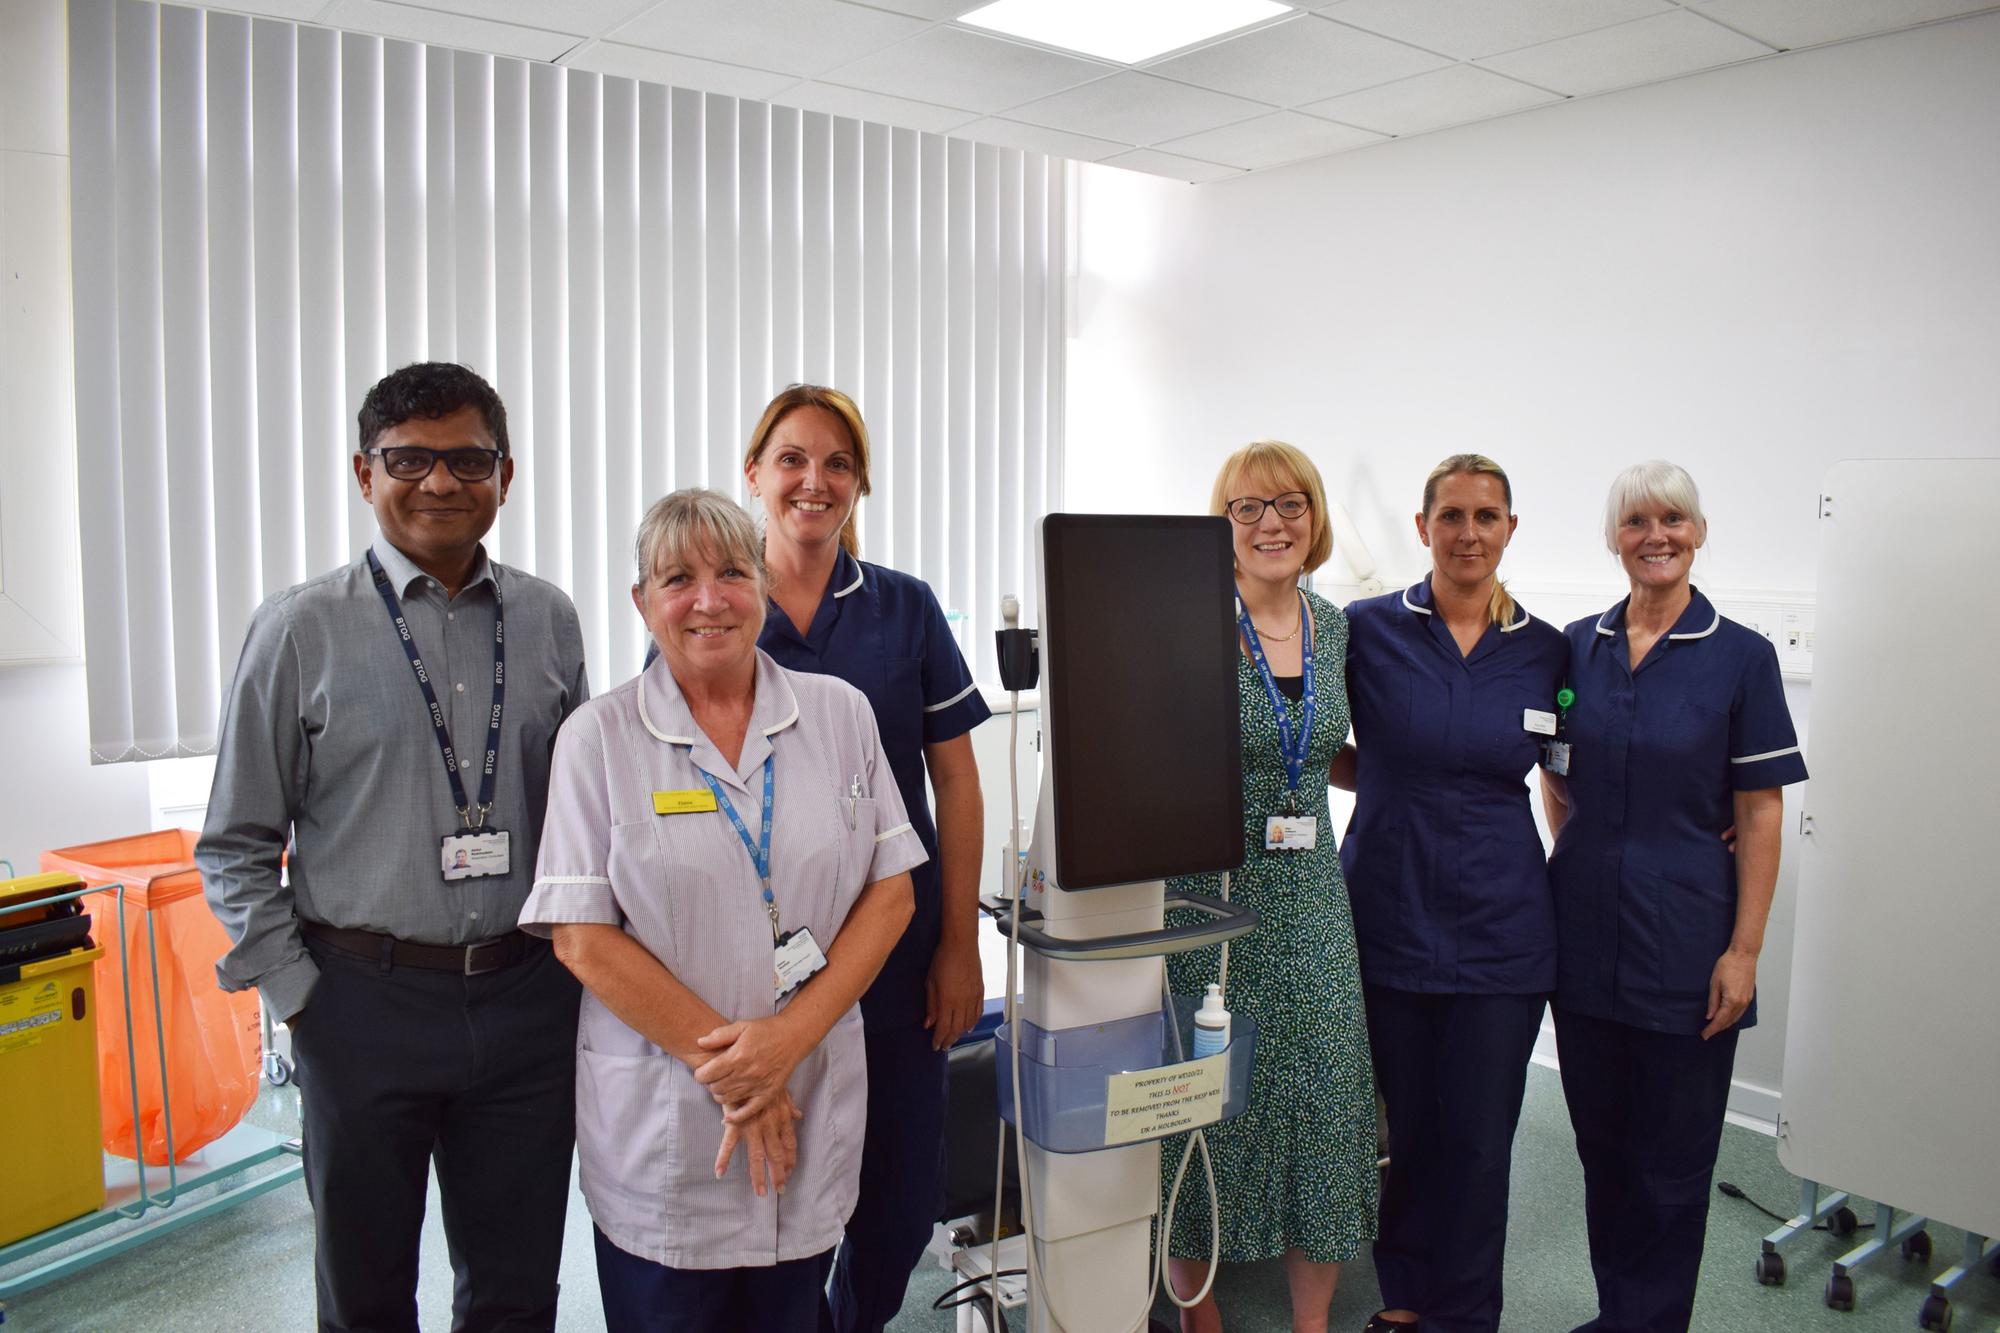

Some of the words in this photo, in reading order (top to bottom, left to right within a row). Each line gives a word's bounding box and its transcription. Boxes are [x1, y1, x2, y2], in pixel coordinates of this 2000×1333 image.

[395, 617, 411, 641] BTOG
[413, 659, 428, 684] BTOG
[495, 661, 503, 684] BTOG
[430, 702, 443, 728] BTOG
[491, 703, 502, 729] BTOG
[443, 747, 457, 773] BTOG
[485, 749, 496, 775] BTOG
[1135, 1077, 1167, 1089] PROPERTY
[1168, 1074, 1177, 1082] OF
[1149, 1090, 1164, 1099] THIS
[1165, 1088, 1172, 1097] IS
[1172, 1082, 1192, 1095] NOT
[1110, 1110, 1120, 1118] TO
[1121, 1108, 1130, 1116] BE
[1130, 1103, 1162, 1115] REMOVED
[1162, 1099, 1181, 1109] FROM
[1182, 1096, 1193, 1104] THE
[1156, 1109, 1180, 1120] THANKS
[1140, 1127, 1151, 1135] DR
